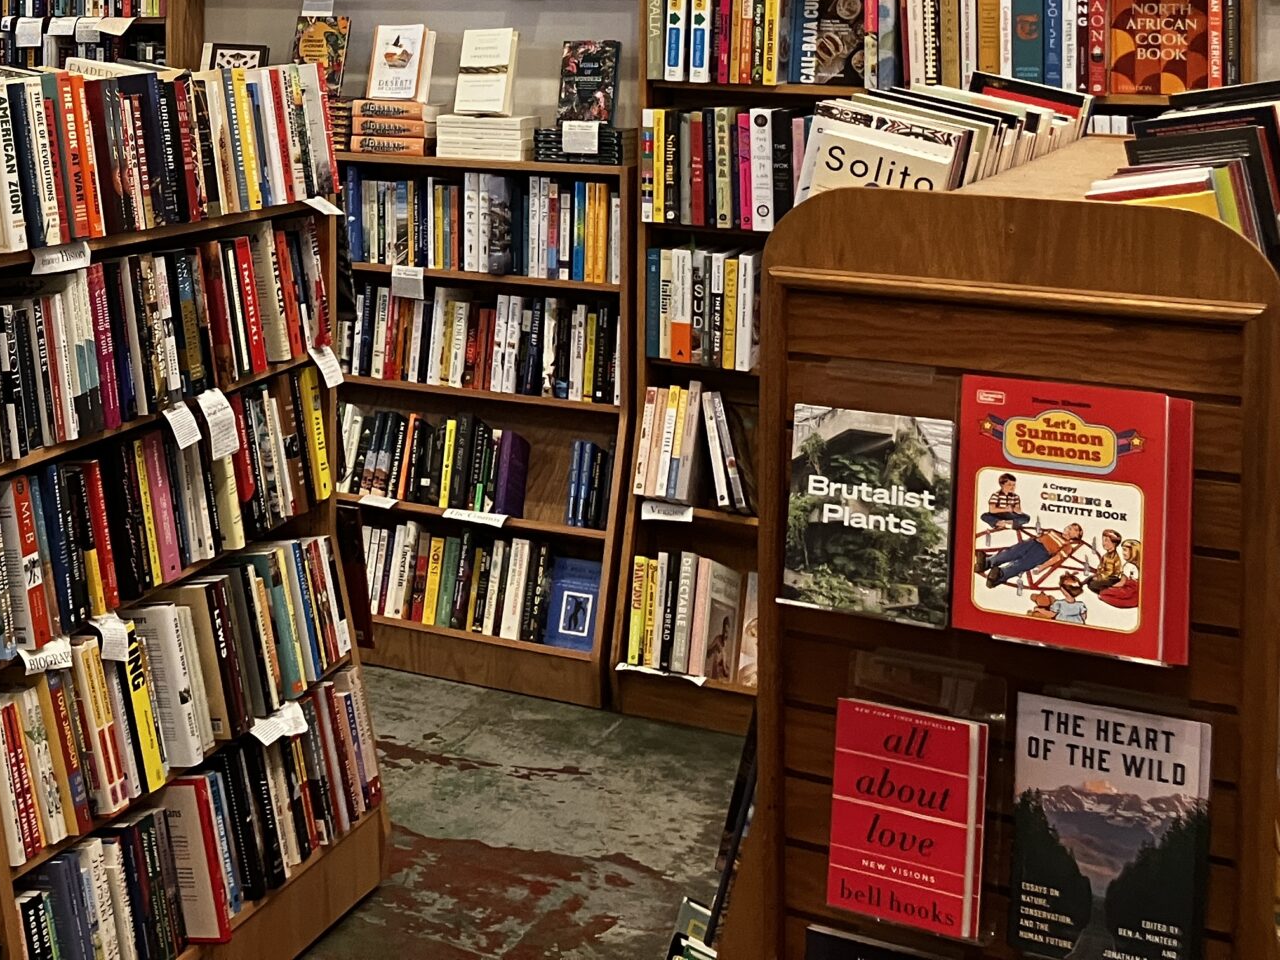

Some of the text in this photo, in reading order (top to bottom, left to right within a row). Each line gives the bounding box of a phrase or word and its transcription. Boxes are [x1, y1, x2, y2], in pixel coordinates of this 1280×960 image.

[1126, 18, 1197, 30] AFRICAN
[1131, 3, 1192, 15] NORTH
[800, 21, 818, 83] CALI-BAJA
[1135, 33, 1188, 46] COOK
[1137, 48, 1187, 60] BOOK
[1210, 30, 1220, 79] AMERICAN
[63, 86, 85, 202] THE BOOK AT WAR
[40, 143, 55, 202] REVOLUTIONS
[825, 146, 934, 191] Solito
[8, 180, 22, 215] ZION
[61, 250, 85, 262] History
[242, 263, 258, 345] IMPERIAL
[452, 306, 464, 350] KINDRED
[1016, 424, 1104, 446] Summon
[1043, 417, 1076, 430] Let's
[1017, 439, 1101, 462] Demons
[807, 474, 936, 511] Brutalist
[1040, 492, 1112, 508] COLORING &
[1050, 484, 1077, 493] Creepy
[21, 502, 31, 531] Mr.
[822, 504, 917, 536] Plants
[1040, 503, 1127, 521] ACTIVITY BOOK
[397, 545, 409, 588] Uncertain
[431, 545, 442, 576] NOISE
[676, 557, 691, 626] DELECTABLE
[127, 628, 145, 692] KING
[56, 691, 78, 768] TOVE JANSSON
[915, 719, 956, 731] BESTSELLER
[1041, 709, 1175, 753] THE HEART
[883, 727, 929, 758] all
[1028, 736, 1186, 786] OF THE WILD
[855, 768, 951, 812] about
[866, 813, 935, 856] love
[861, 859, 936, 884] NEW VISIONS
[839, 878, 955, 927] bell hooks
[1021, 882, 1060, 897] ESSAYS ON
[28, 909, 41, 954] PAGEBOY
[1019, 930, 1072, 949] HUMAN FUTURE
[1020, 918, 1049, 931] AND THE
[1141, 920, 1166, 933] EDITED
[1161, 948, 1178, 959] AND
